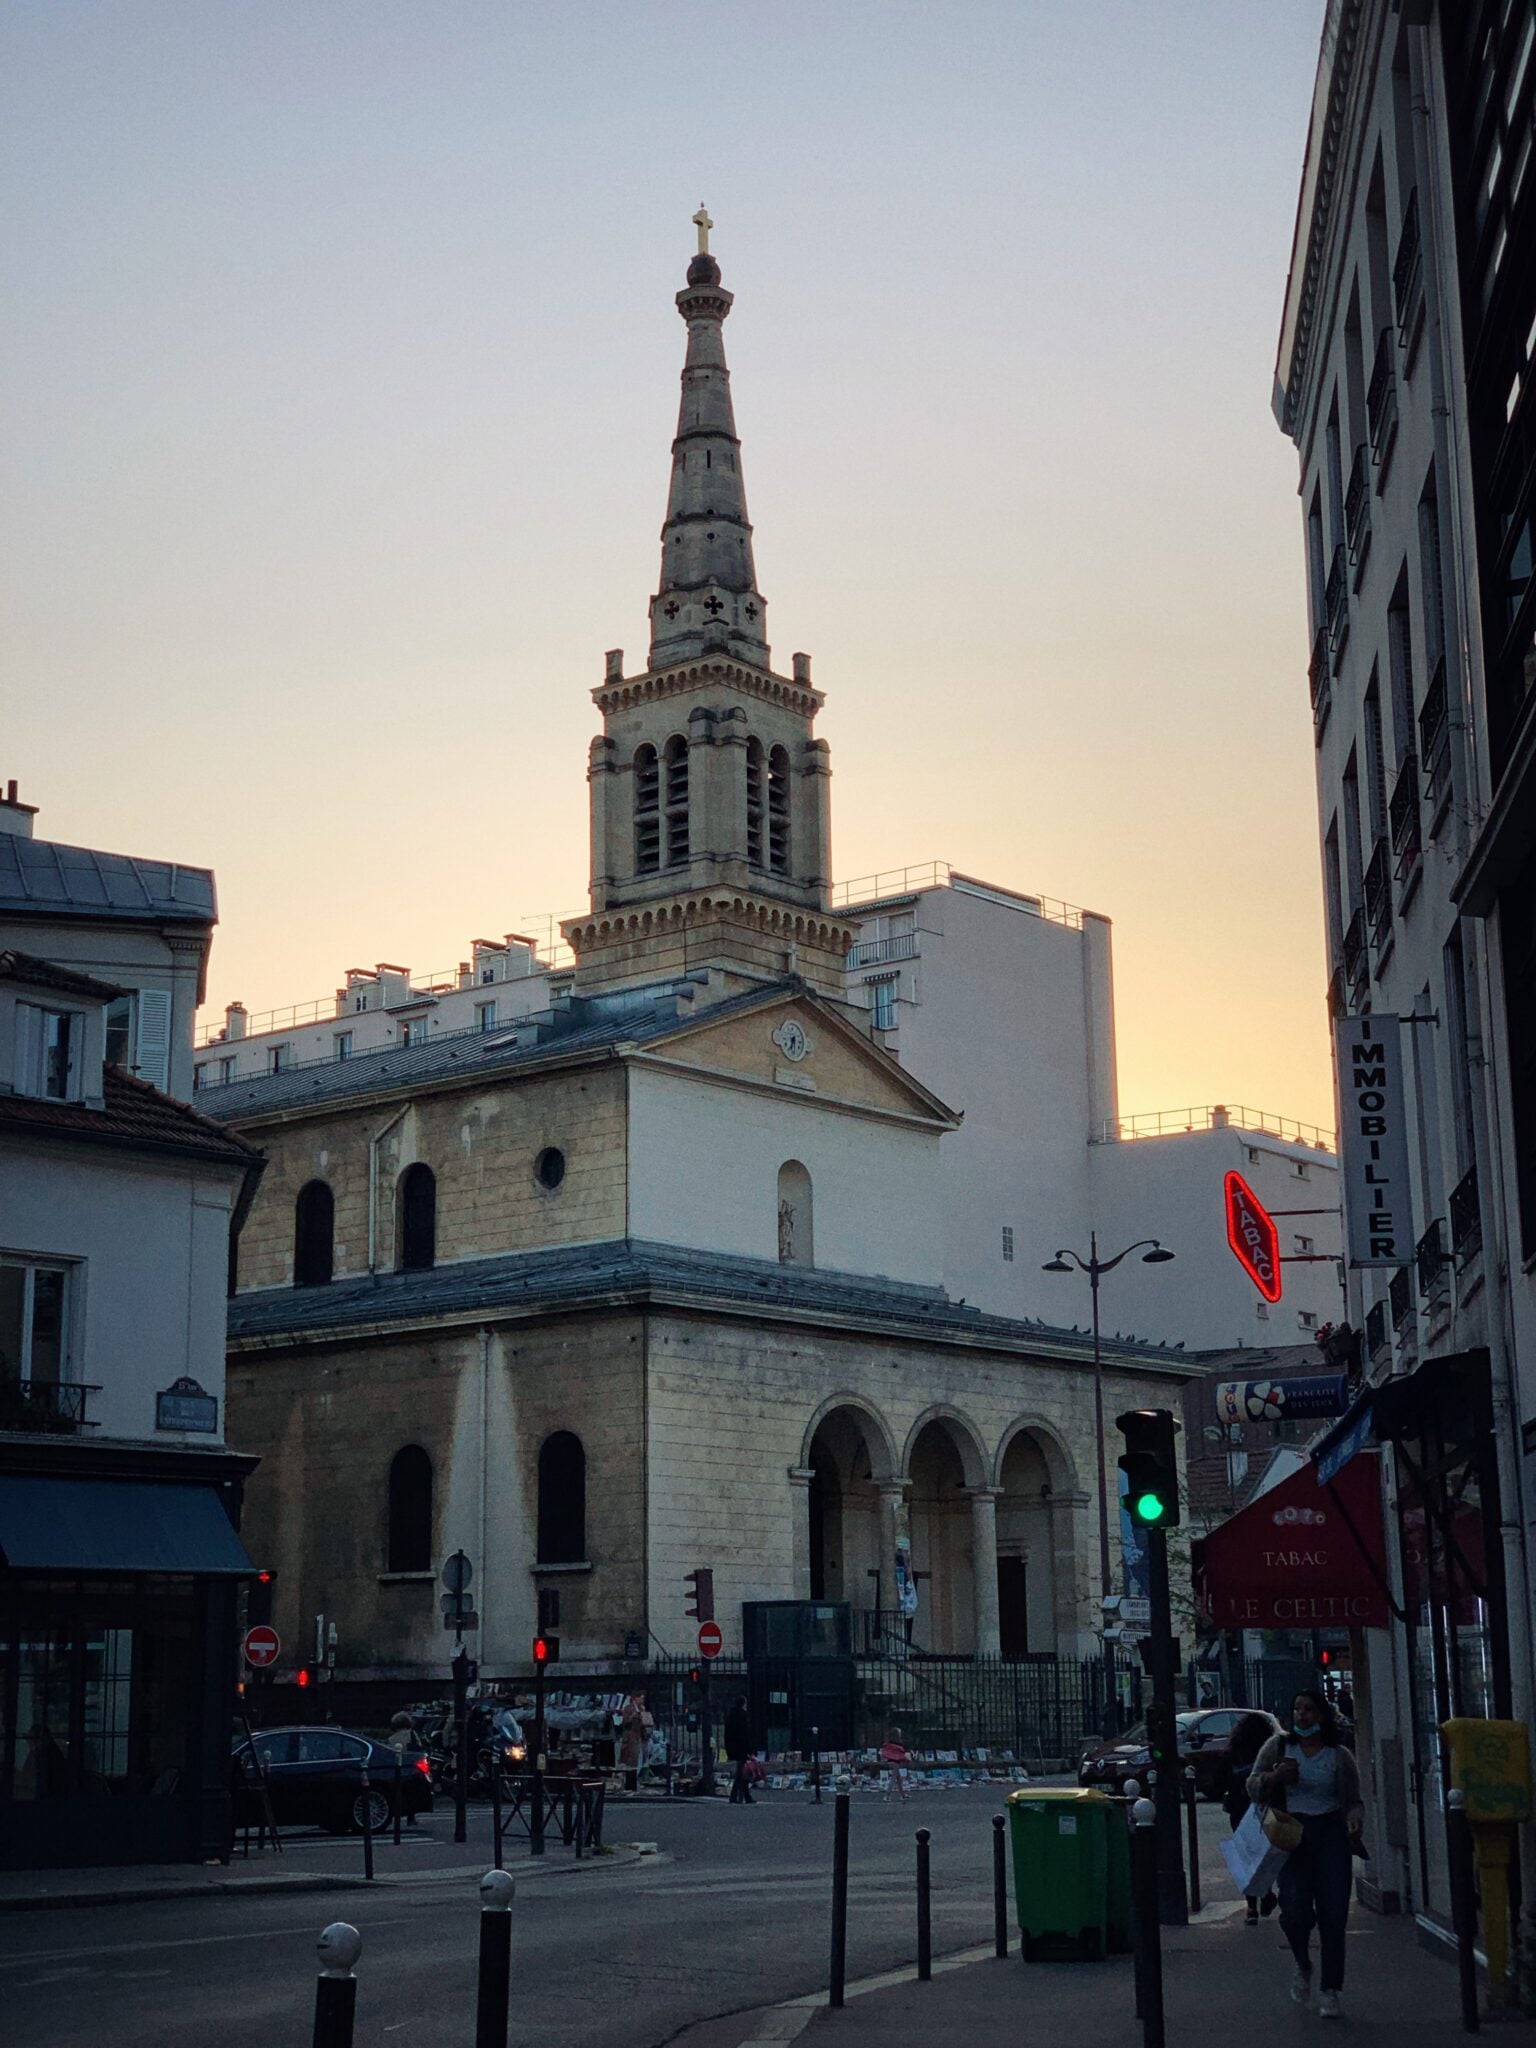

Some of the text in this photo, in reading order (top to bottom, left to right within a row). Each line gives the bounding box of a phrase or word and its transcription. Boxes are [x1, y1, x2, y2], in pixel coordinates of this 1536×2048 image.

[1352, 1020, 1395, 1258] IMMOBILIER
[1232, 1191, 1273, 1281] TABAC
[1262, 1550, 1328, 1567] TABAC
[1230, 1596, 1371, 1619] LE CELTIC
